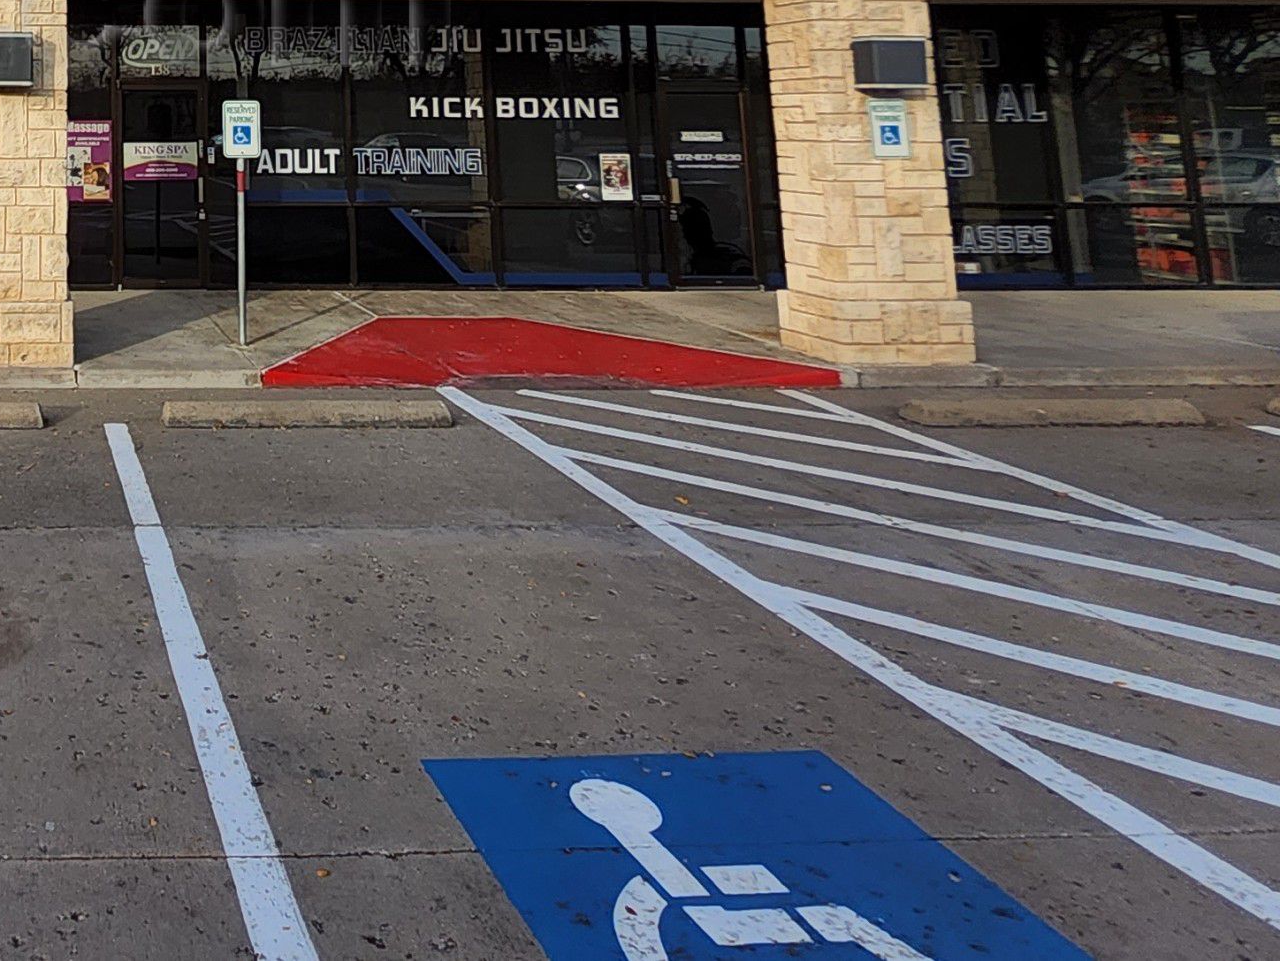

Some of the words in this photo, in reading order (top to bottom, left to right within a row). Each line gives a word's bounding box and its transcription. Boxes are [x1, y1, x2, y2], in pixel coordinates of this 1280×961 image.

[127, 38, 196, 60] OPEN
[244, 26, 420, 54] BRAZILIAN
[431, 28, 483, 53] JIU
[496, 28, 587, 53] JITSU
[409, 96, 484, 119] KICK
[495, 96, 620, 120] BOXING
[943, 83, 1048, 123] TIAL
[256, 147, 341, 175] ADULT
[352, 148, 483, 175] TRAINING
